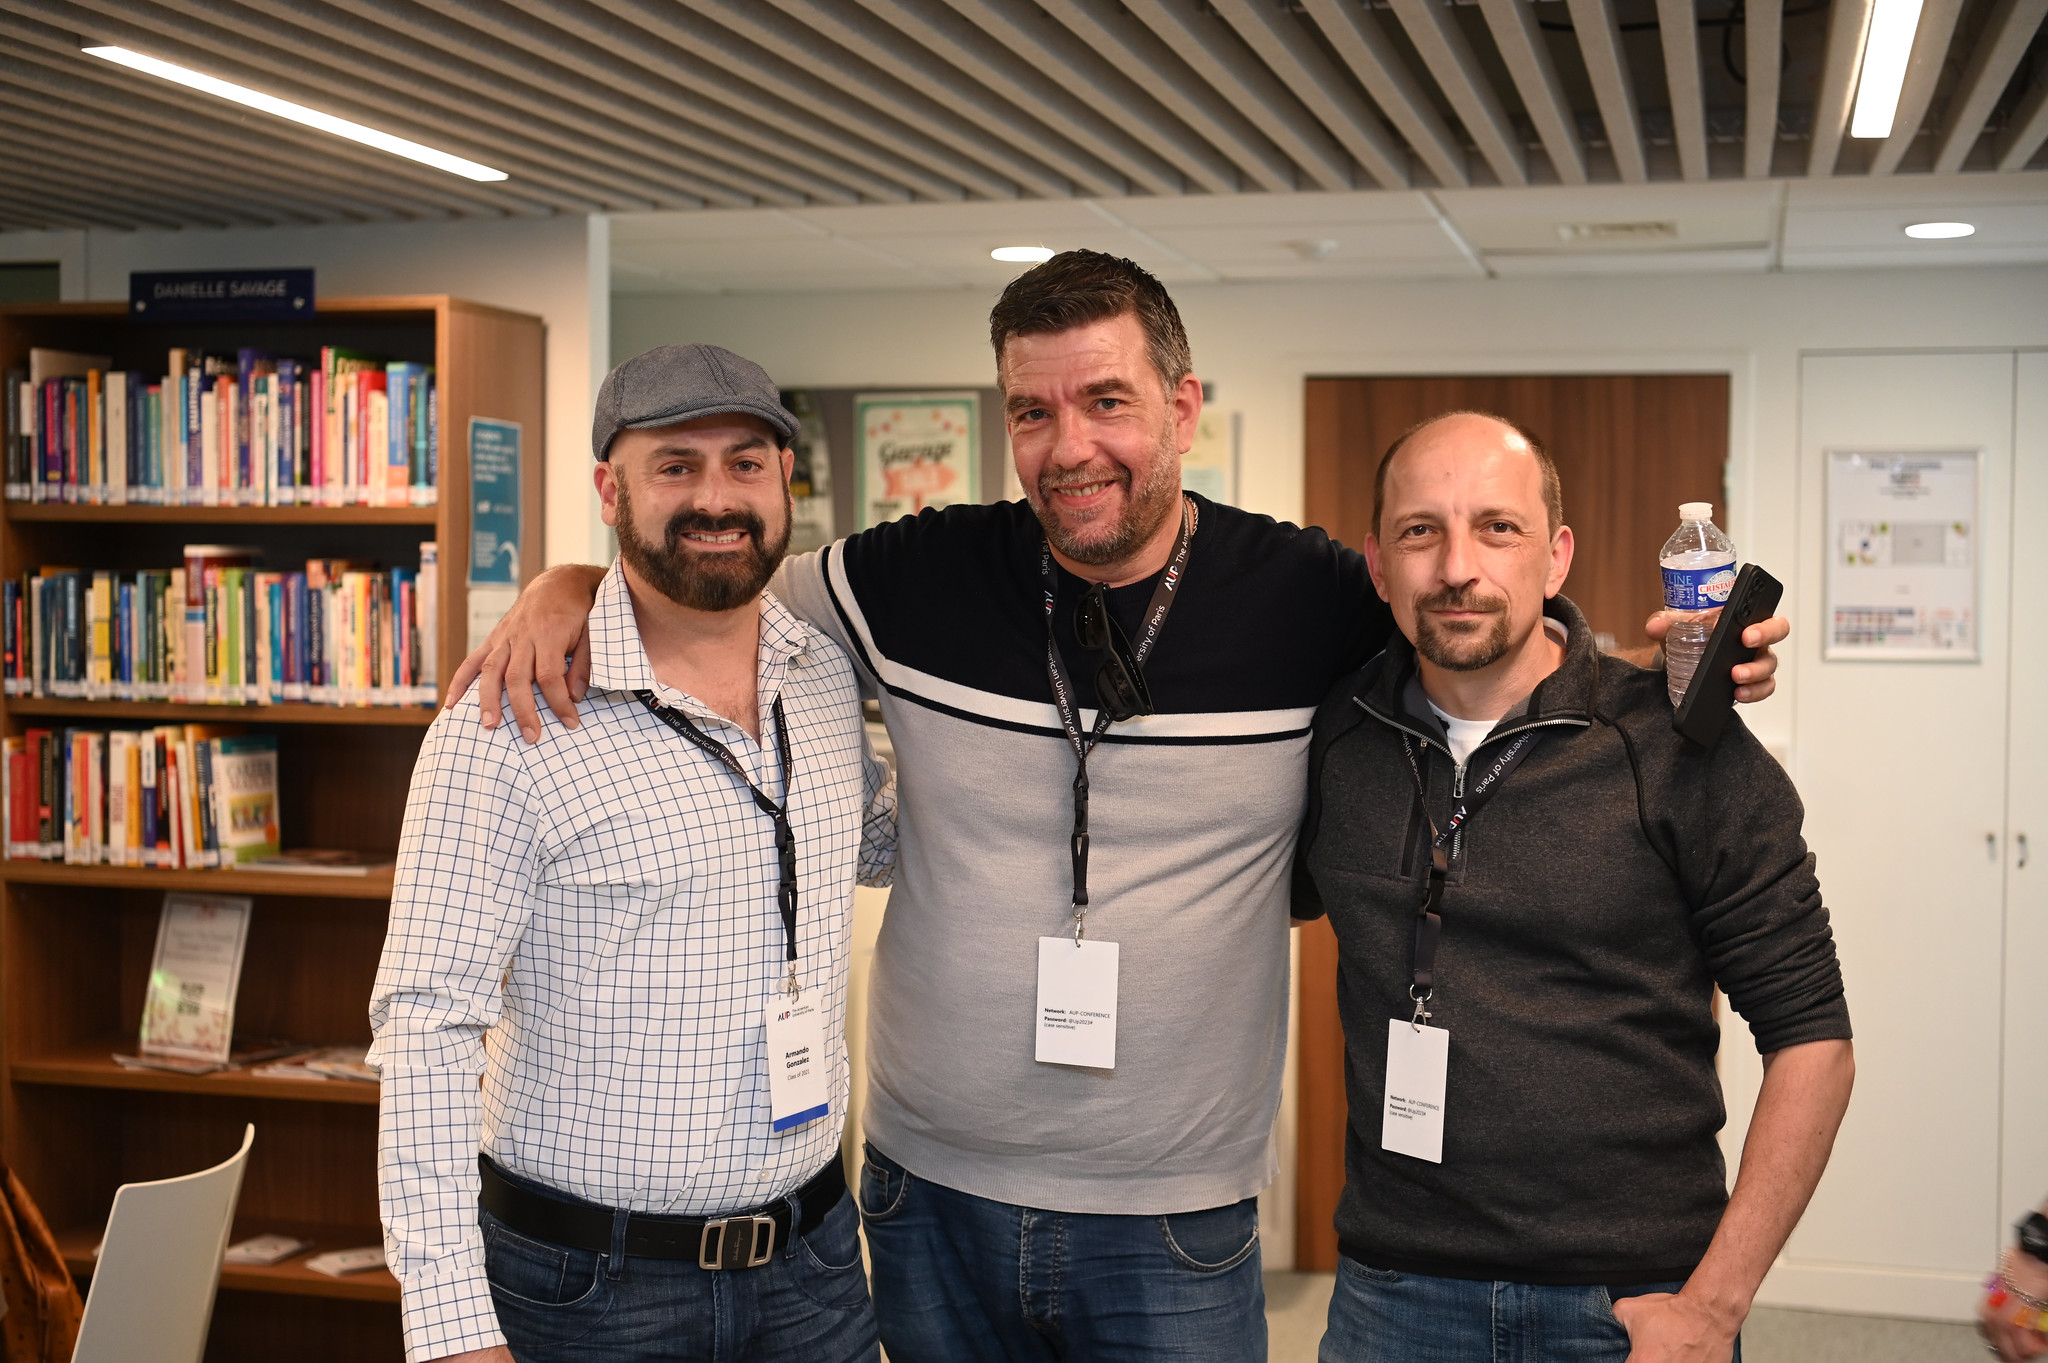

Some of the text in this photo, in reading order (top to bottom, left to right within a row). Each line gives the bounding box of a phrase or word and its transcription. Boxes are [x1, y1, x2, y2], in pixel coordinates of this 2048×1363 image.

[153, 279, 288, 299] DANIELLE SAVAGE
[1041, 554, 1051, 576] Paris
[1175, 548, 1187, 563] The
[1664, 573, 1693, 585] ELINE
[1136, 605, 1166, 662] ersity of Paris
[1055, 680, 1073, 725] University
[1068, 725, 1079, 738] of
[665, 713, 681, 727] The
[680, 726, 720, 754] American
[720, 751, 748, 779] Univers
[1475, 729, 1537, 794] University of Paris
[1069, 1010, 1110, 1019] AUP-CONFERENCE
[785, 1046, 809, 1059] Armando
[786, 1057, 809, 1069] Gonzalez
